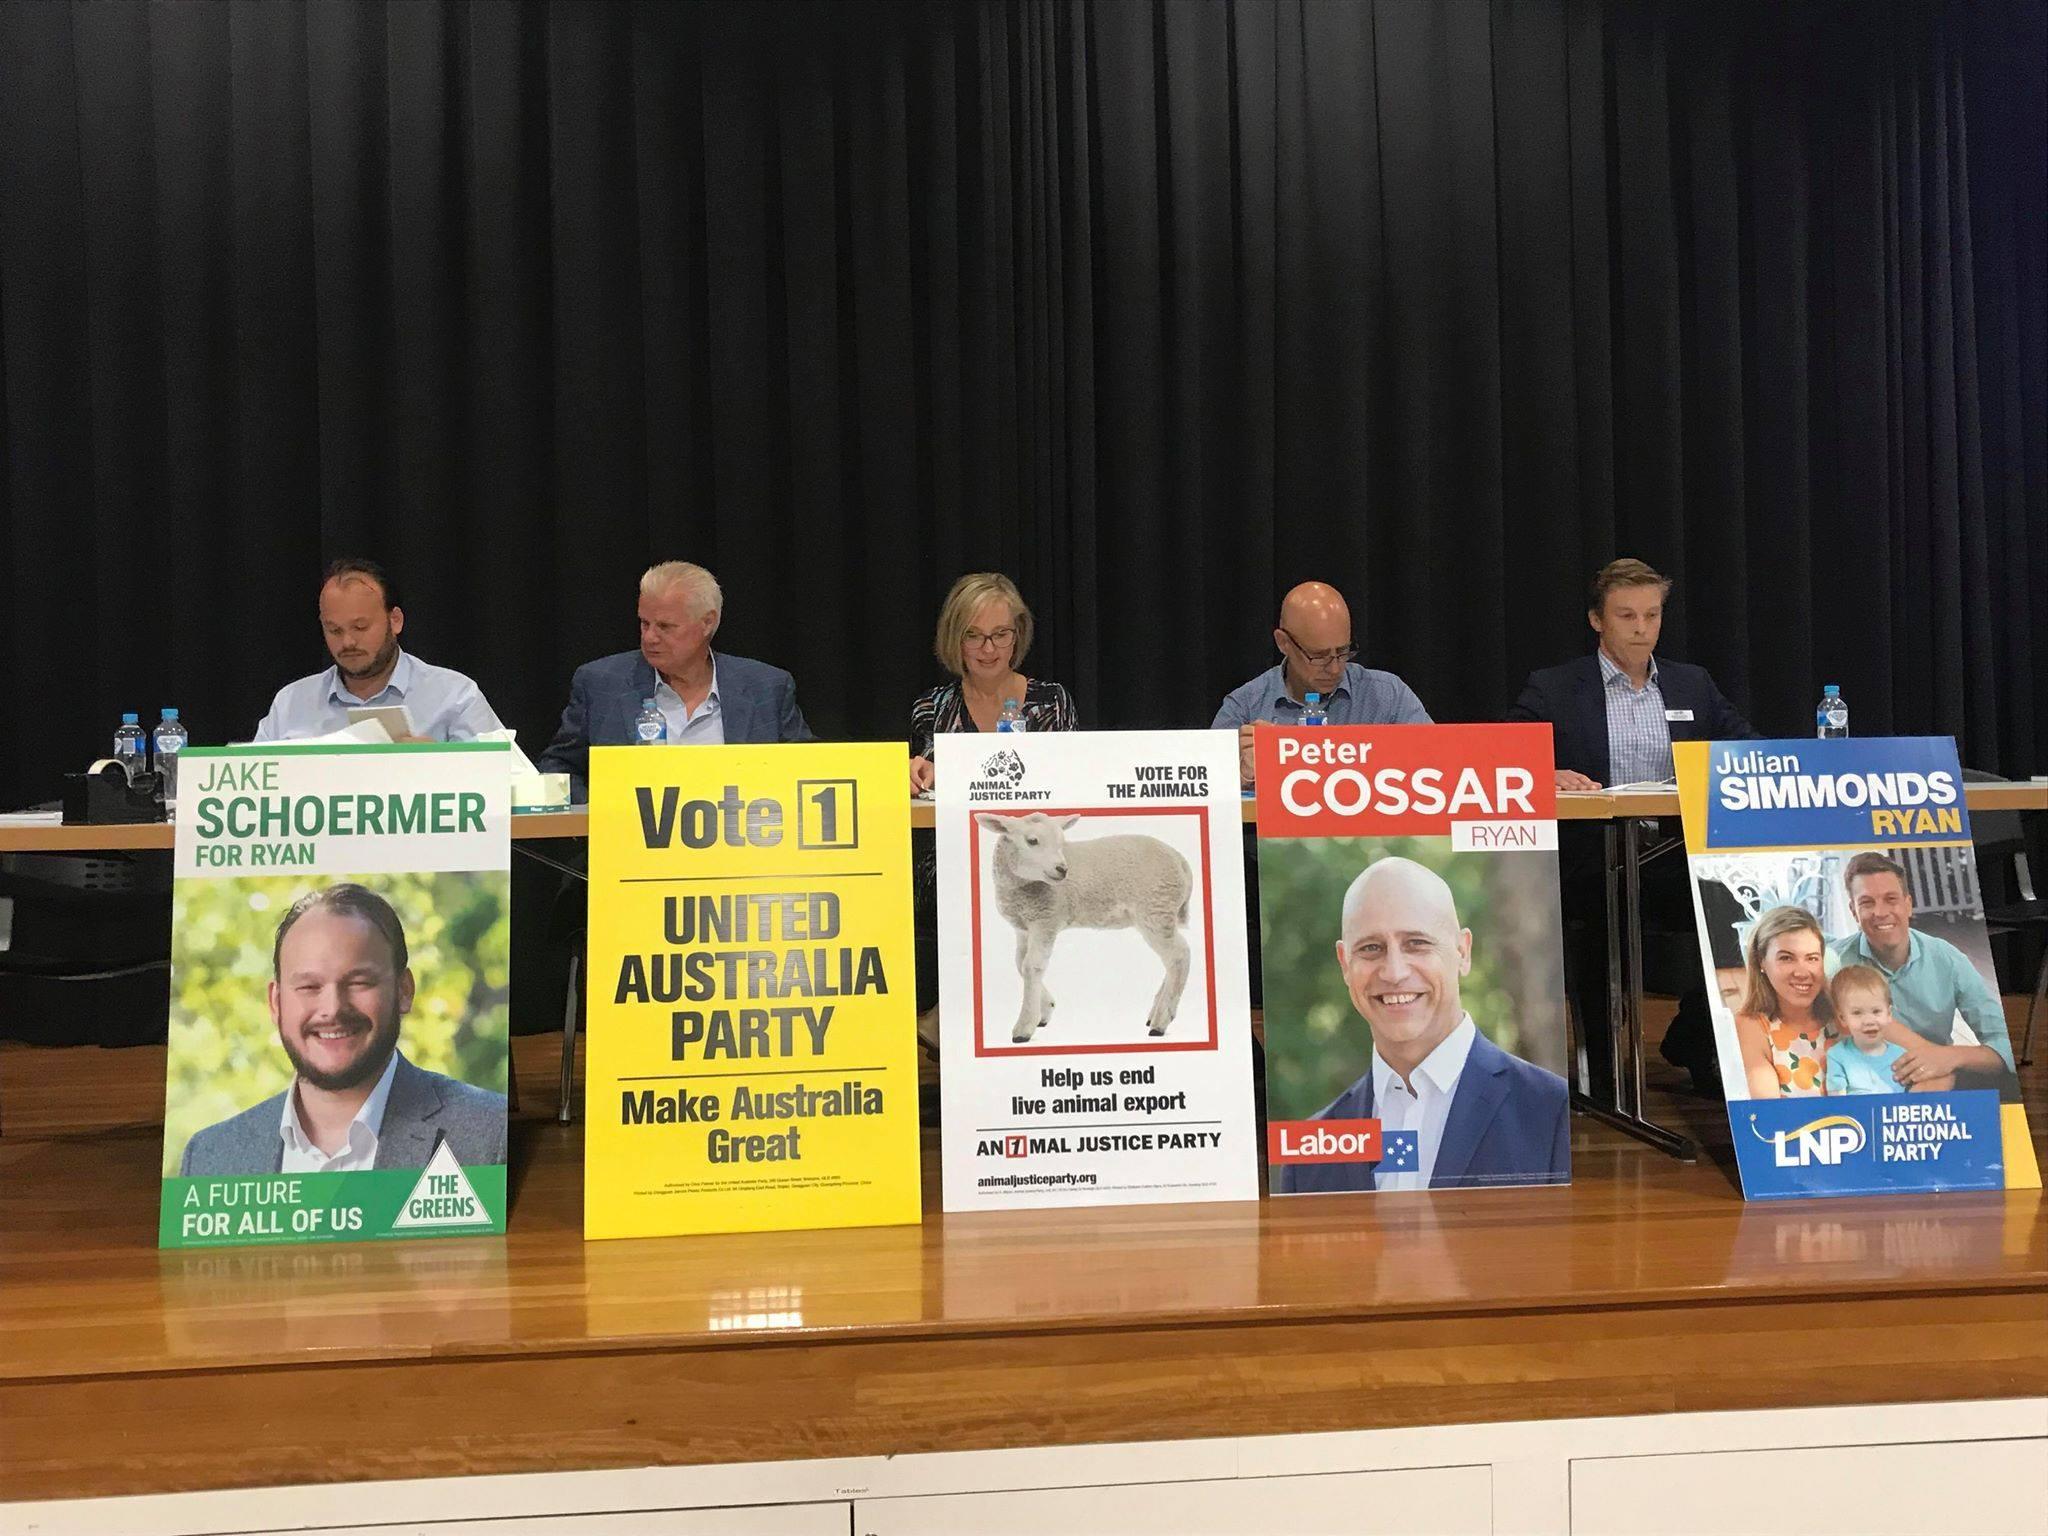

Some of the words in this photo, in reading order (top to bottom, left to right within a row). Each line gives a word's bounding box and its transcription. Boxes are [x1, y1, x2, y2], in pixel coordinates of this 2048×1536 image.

[1279, 739, 1372, 764] Peter
[1717, 751, 1800, 775] Julian
[199, 761, 280, 793] JAKE
[969, 781, 1012, 790] ANIMAL
[1134, 766, 1174, 781] VOTE
[1177, 766, 1208, 781] FOR
[969, 791, 1013, 801] JUSTICE
[1015, 791, 1052, 801] PARTY
[1106, 783, 1136, 799] THE
[1139, 782, 1209, 798] ANIMALS
[1280, 767, 1536, 817] COSSAR
[1720, 772, 1957, 810] SIMMONDS
[196, 792, 487, 839] SCHOERMER
[635, 785, 783, 850] Vote
[811, 787, 838, 843] 1
[1871, 808, 1962, 836] RYAN
[1471, 826, 1537, 847] RYAN
[196, 844, 242, 868] FOR
[250, 842, 315, 866] RYAN
[663, 892, 840, 945] UNITED
[613, 946, 889, 1005] AUSTRALIA
[671, 1006, 835, 1061] PARTY
[1041, 1067, 1084, 1091] Help
[1090, 1070, 1114, 1086] us
[1119, 1066, 1155, 1085] end
[621, 1089, 720, 1125] Make
[730, 1081, 883, 1121] Australia
[1011, 1096, 1046, 1115] live
[1051, 1093, 1118, 1114] animal
[1123, 1091, 1187, 1114] export
[1882, 1104, 1957, 1122] LIBERAL
[707, 1125, 802, 1164] Great
[1076, 1134, 1154, 1153] JUSTICE
[1157, 1132, 1222, 1150] PARTY
[1280, 1128, 1371, 1156] Labor
[1882, 1122, 1973, 1142] NATIONAL
[1774, 1128, 1859, 1167] LNP
[1883, 1143, 1943, 1162] PARTY
[427, 1174, 460, 1196] THE
[977, 1173, 1098, 1188] animaljusticeparty.org
[183, 1185, 201, 1208] A
[209, 1180, 302, 1207] FUTURE
[408, 1196, 477, 1220] GREENS
[182, 1213, 231, 1238] FOR
[237, 1210, 284, 1235] ALL
[291, 1208, 323, 1233] OF
[331, 1206, 363, 1231] US
